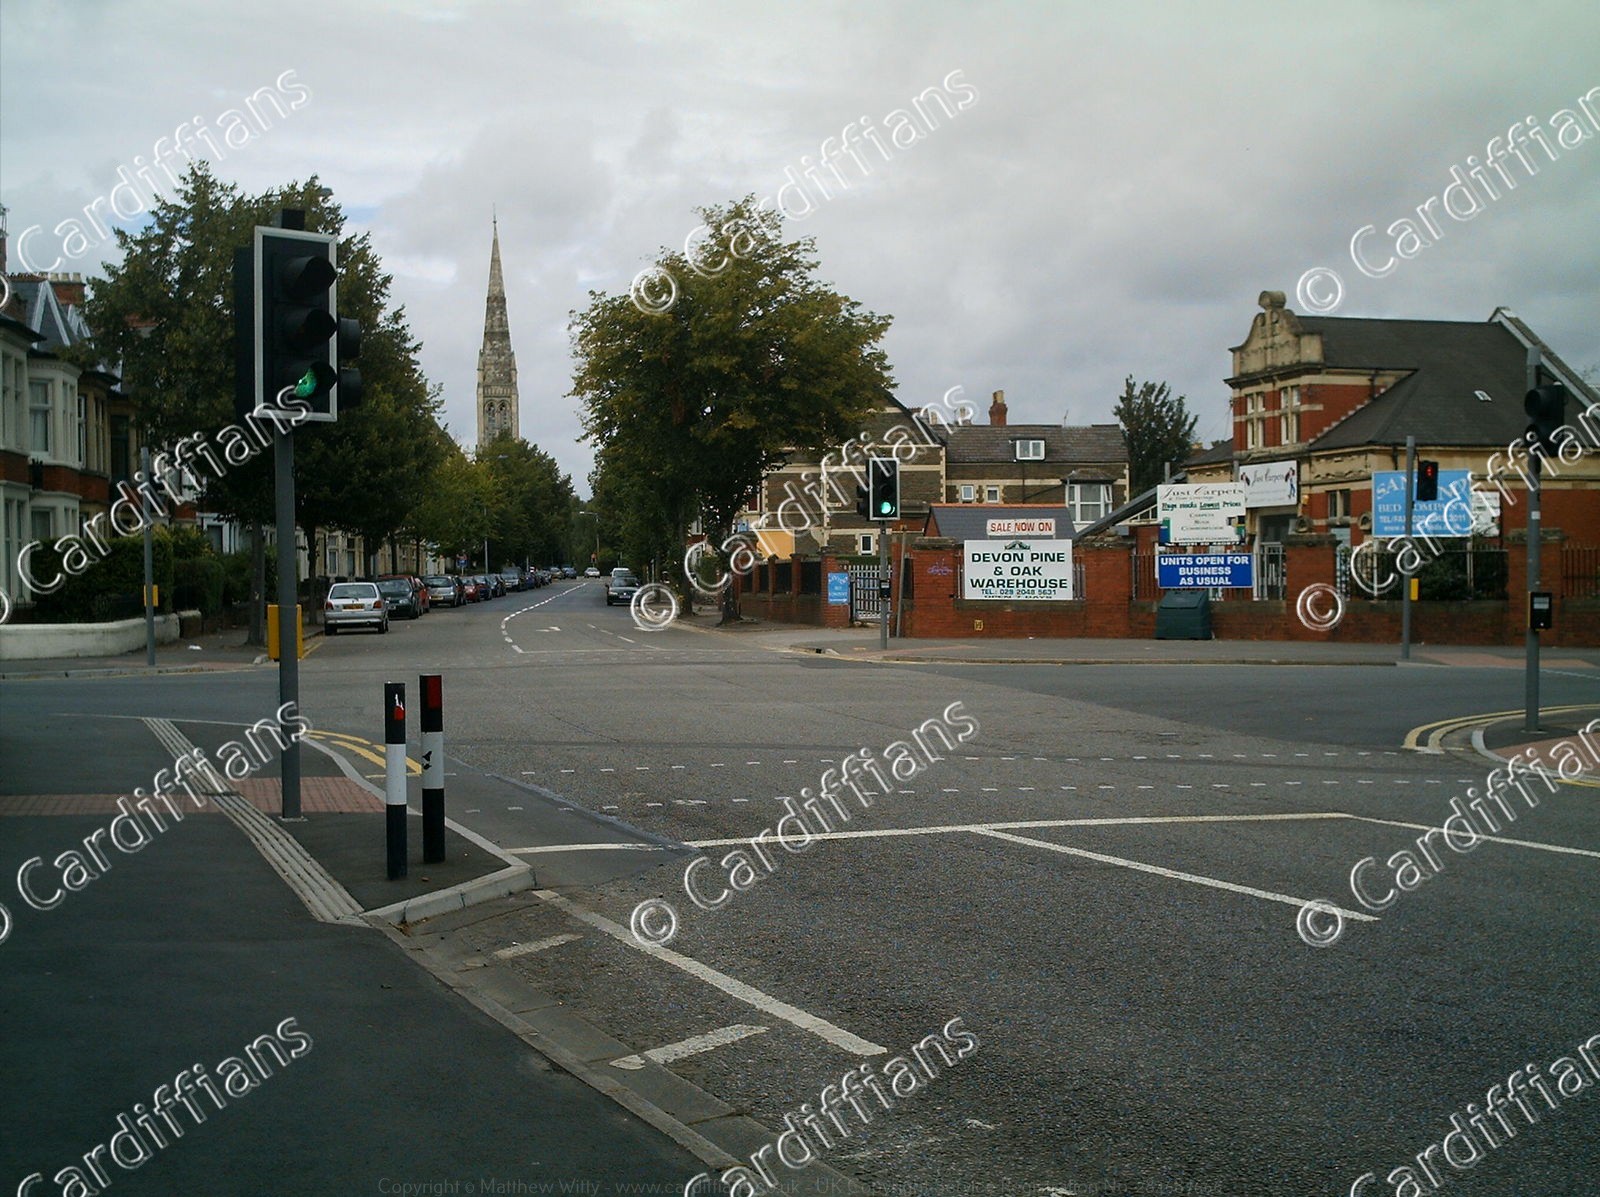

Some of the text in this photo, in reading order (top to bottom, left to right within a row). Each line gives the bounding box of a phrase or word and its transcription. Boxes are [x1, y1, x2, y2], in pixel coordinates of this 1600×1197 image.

[991, 522, 1052, 532] SALE NOW ON
[972, 553, 1065, 562] DEVON PINE
[1161, 556, 1249, 565] UNITS OPEN FOR
[994, 566, 1042, 576] & OAK
[1179, 567, 1231, 575] BUSINESS
[970, 579, 1067, 588] WAREHOUSE
[1179, 576, 1232, 585] AS USUAL
